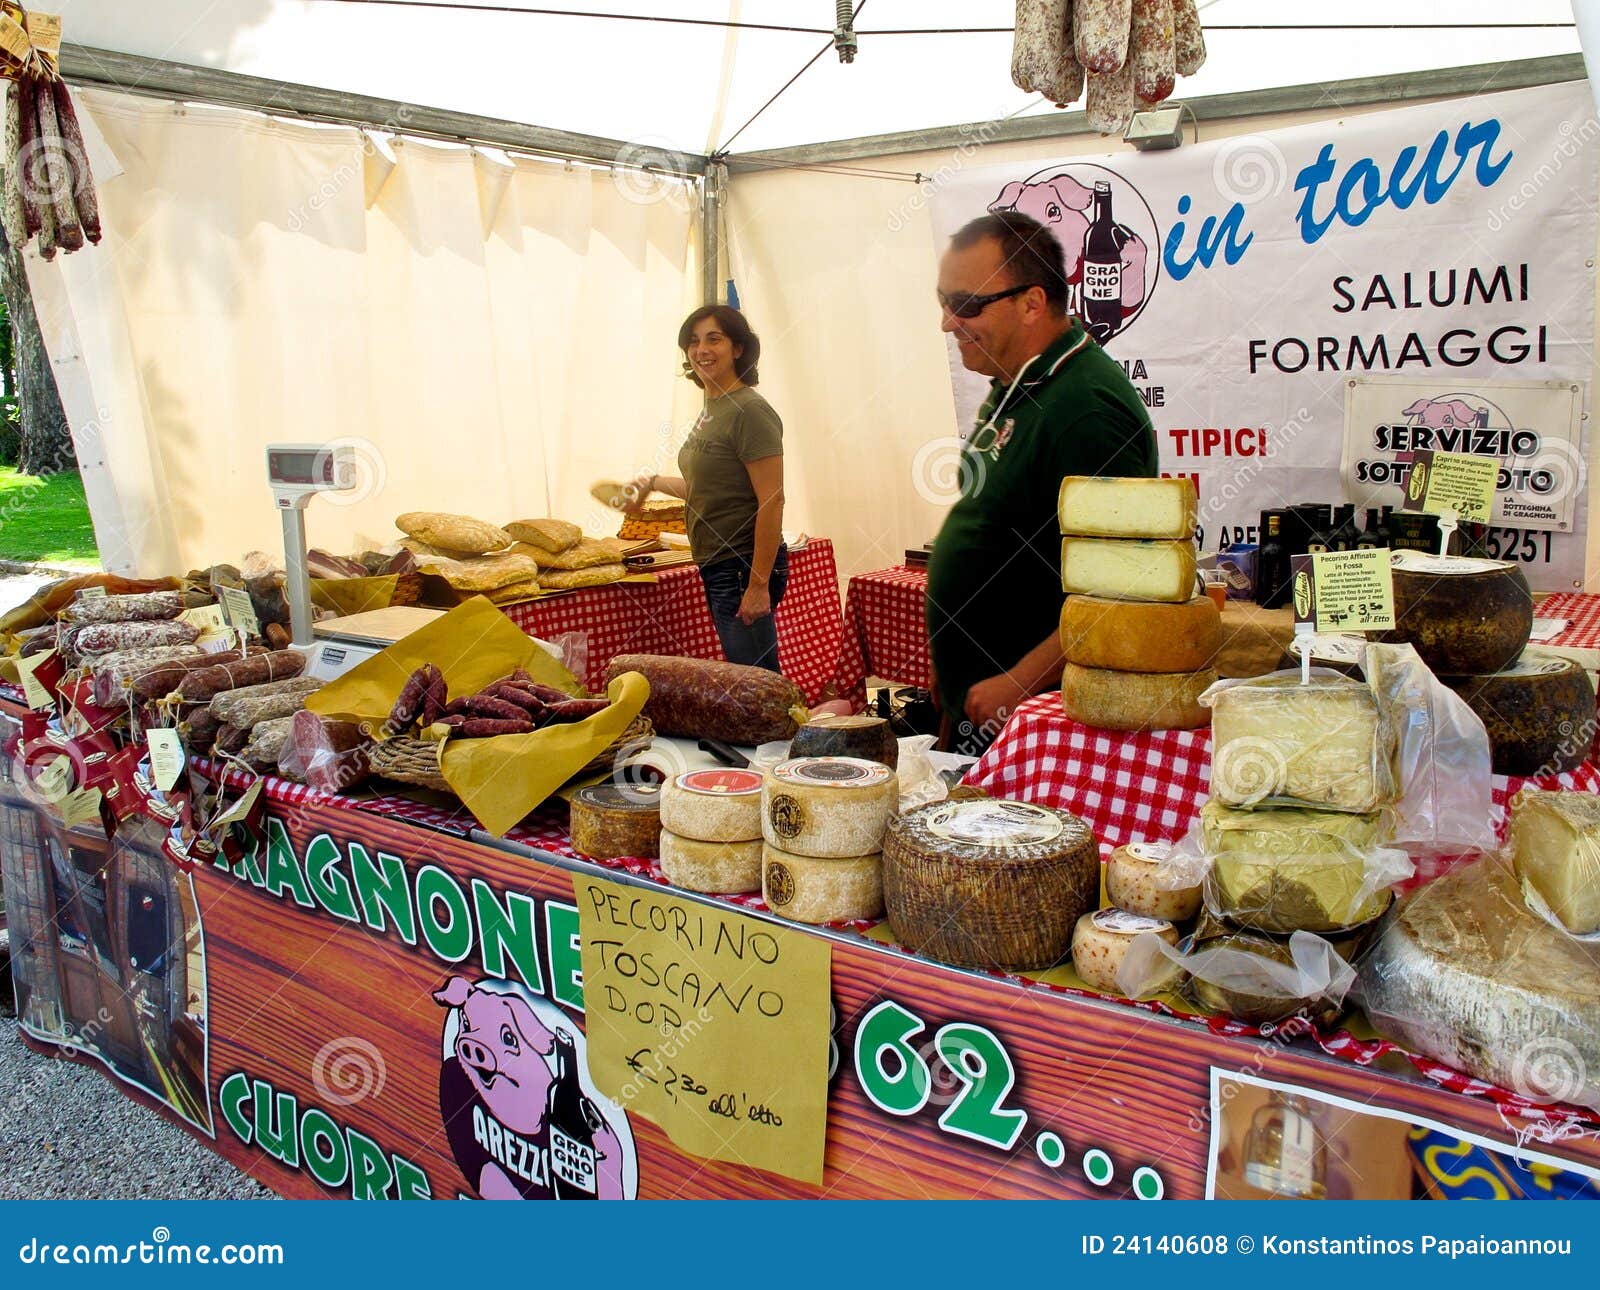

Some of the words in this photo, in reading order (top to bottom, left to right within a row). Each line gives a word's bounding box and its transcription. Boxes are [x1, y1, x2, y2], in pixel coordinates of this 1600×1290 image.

[1163, 195, 1253, 281] in
[1294, 118, 1513, 245] tour
[1086, 266, 1118, 276] GRA
[1086, 276, 1118, 286] GNO
[1092, 288, 1112, 298] NE
[1332, 263, 1528, 313] SALUMI
[1249, 325, 1546, 374] FORMAGGI
[1169, 429, 1267, 457] TIPICI
[1375, 424, 1540, 458] SERVIZIO
[1348, 604, 1355, 612] €
[588, 886, 778, 964] PECORINO
[591, 940, 783, 1016] TOSCANO
[553, 1133, 591, 1161] GRA
[554, 1149, 593, 1175] GNO
[561, 1165, 586, 1186] NE
